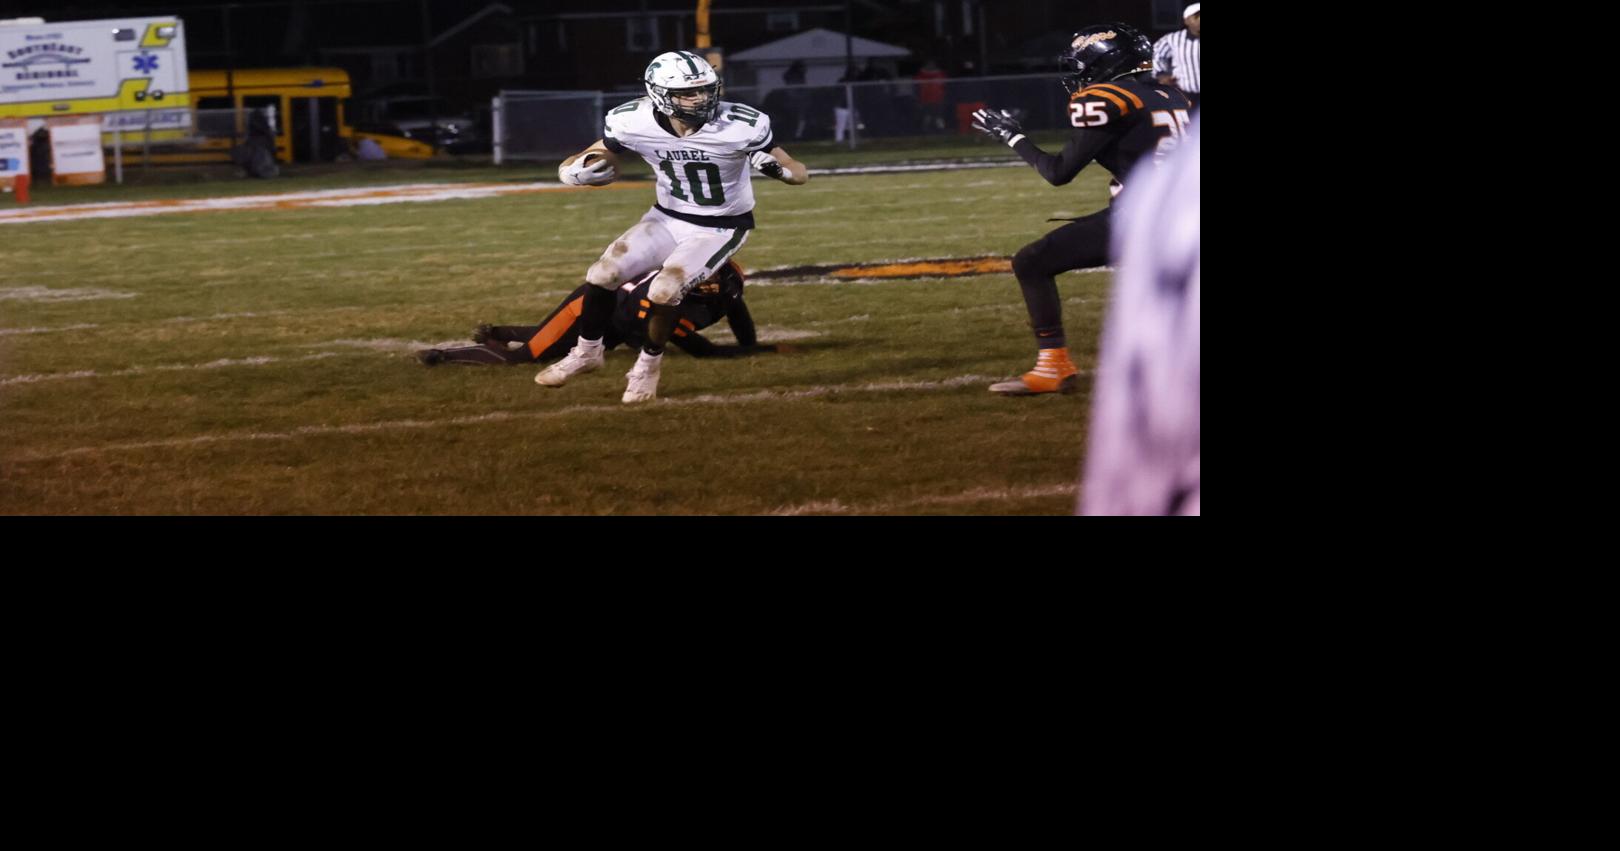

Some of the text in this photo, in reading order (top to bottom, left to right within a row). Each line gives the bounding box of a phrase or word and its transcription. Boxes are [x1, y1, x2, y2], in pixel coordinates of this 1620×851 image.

[727, 104, 760, 128] 10
[1069, 101, 1109, 128] 25
[655, 150, 709, 161] LAUREL
[659, 159, 726, 206] 10
